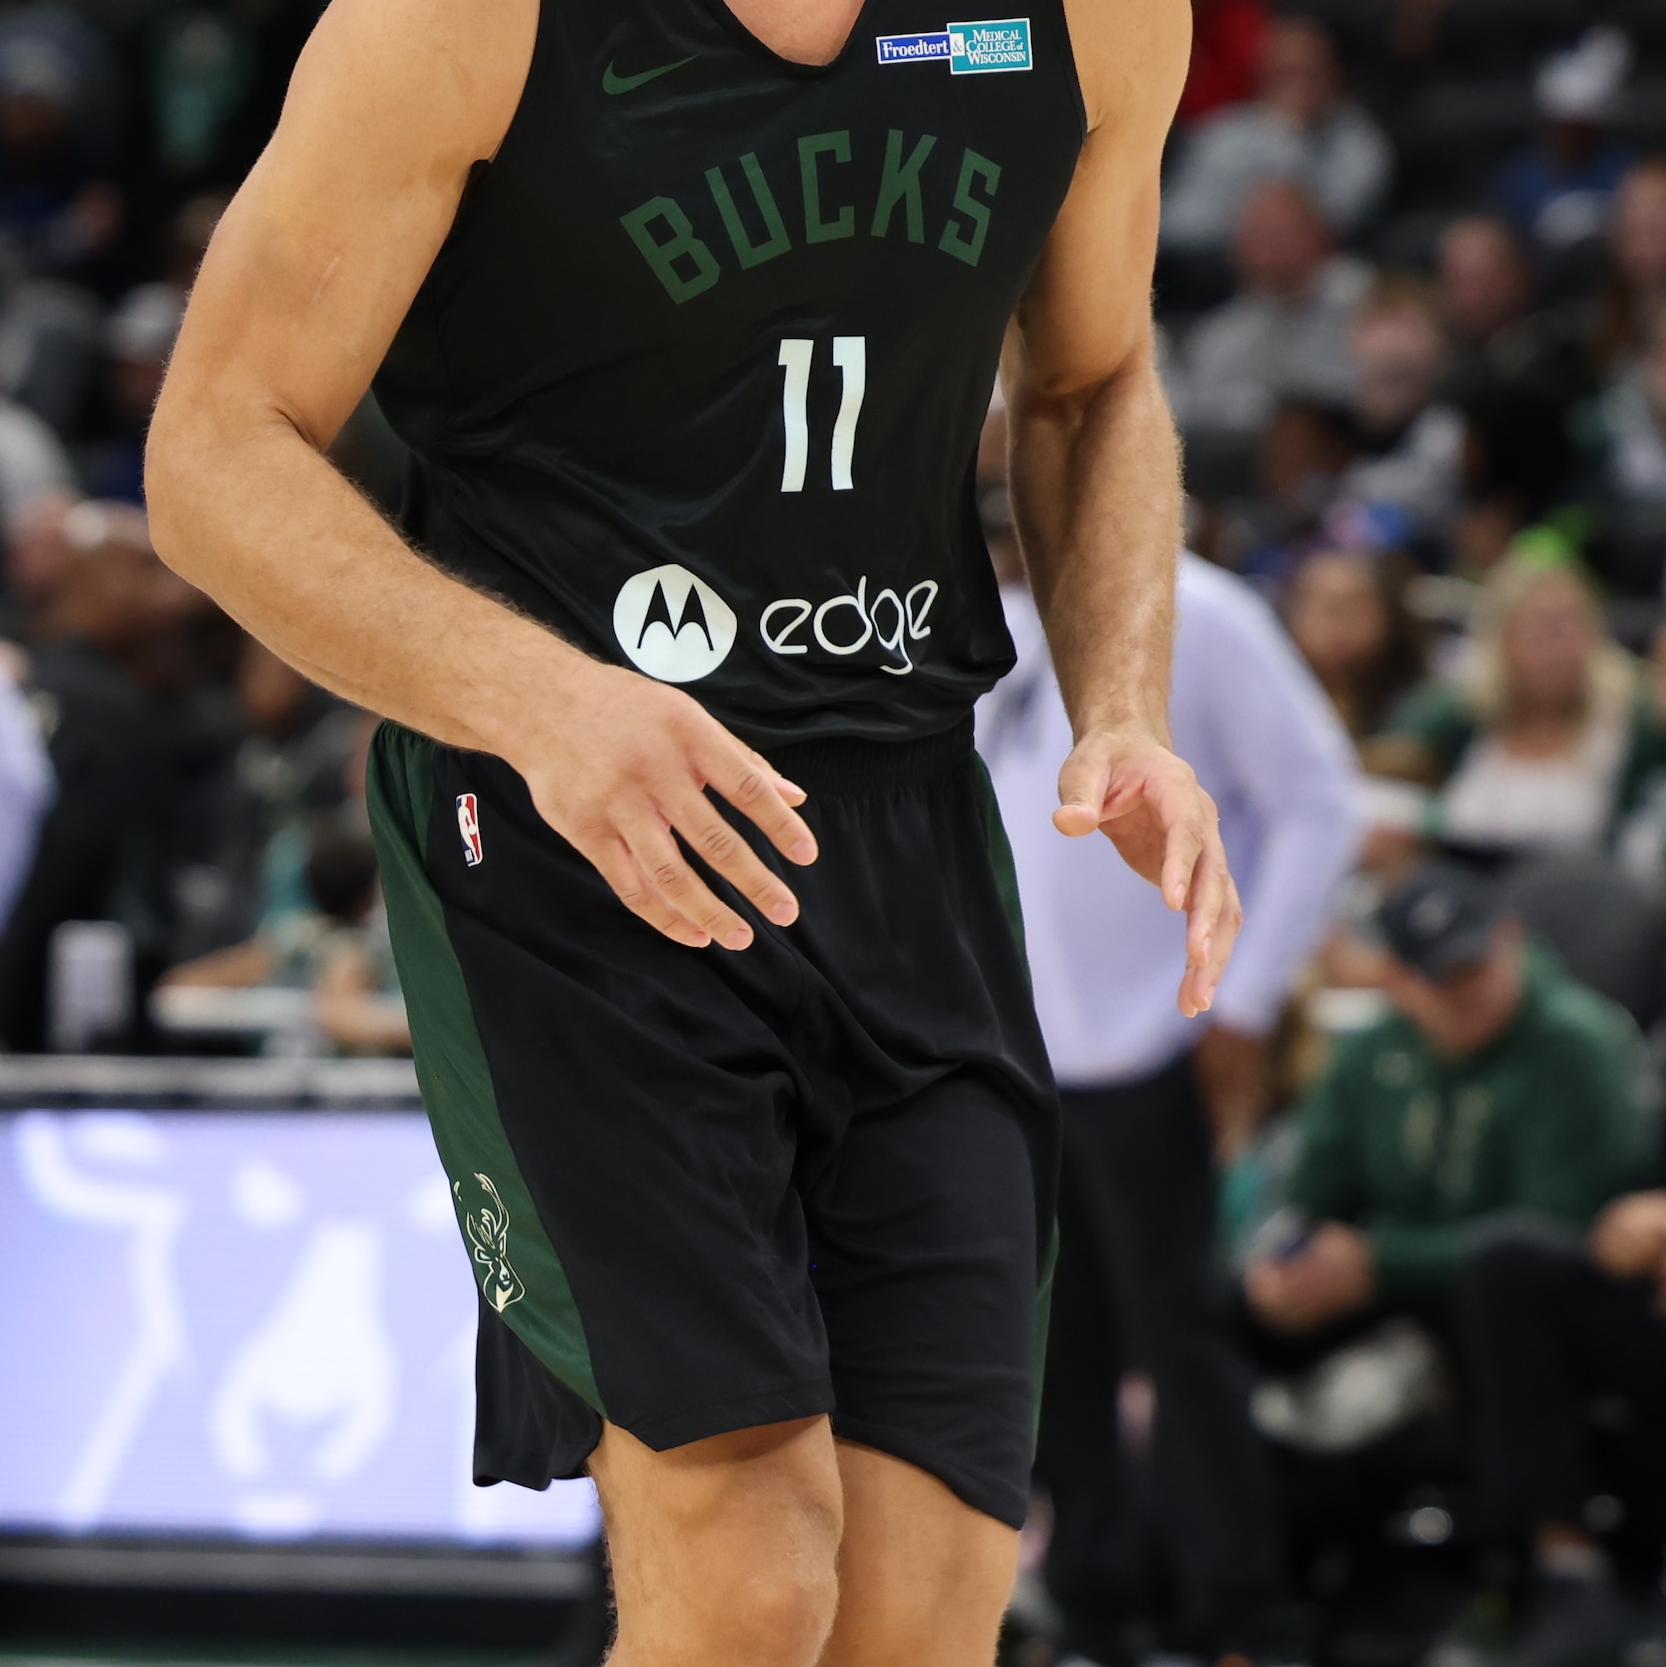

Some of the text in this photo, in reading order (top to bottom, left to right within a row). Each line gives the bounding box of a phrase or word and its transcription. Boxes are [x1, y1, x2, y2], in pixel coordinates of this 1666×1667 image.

[972, 29, 1022, 43] MEDICAL
[881, 39, 963, 59] Froedtert &
[966, 40, 1017, 53] COLLEGE
[966, 51, 1027, 65] WISCONSIN
[620, 128, 1002, 305] BUCKS
[777, 336, 866, 493] 11
[759, 575, 939, 675] edge
